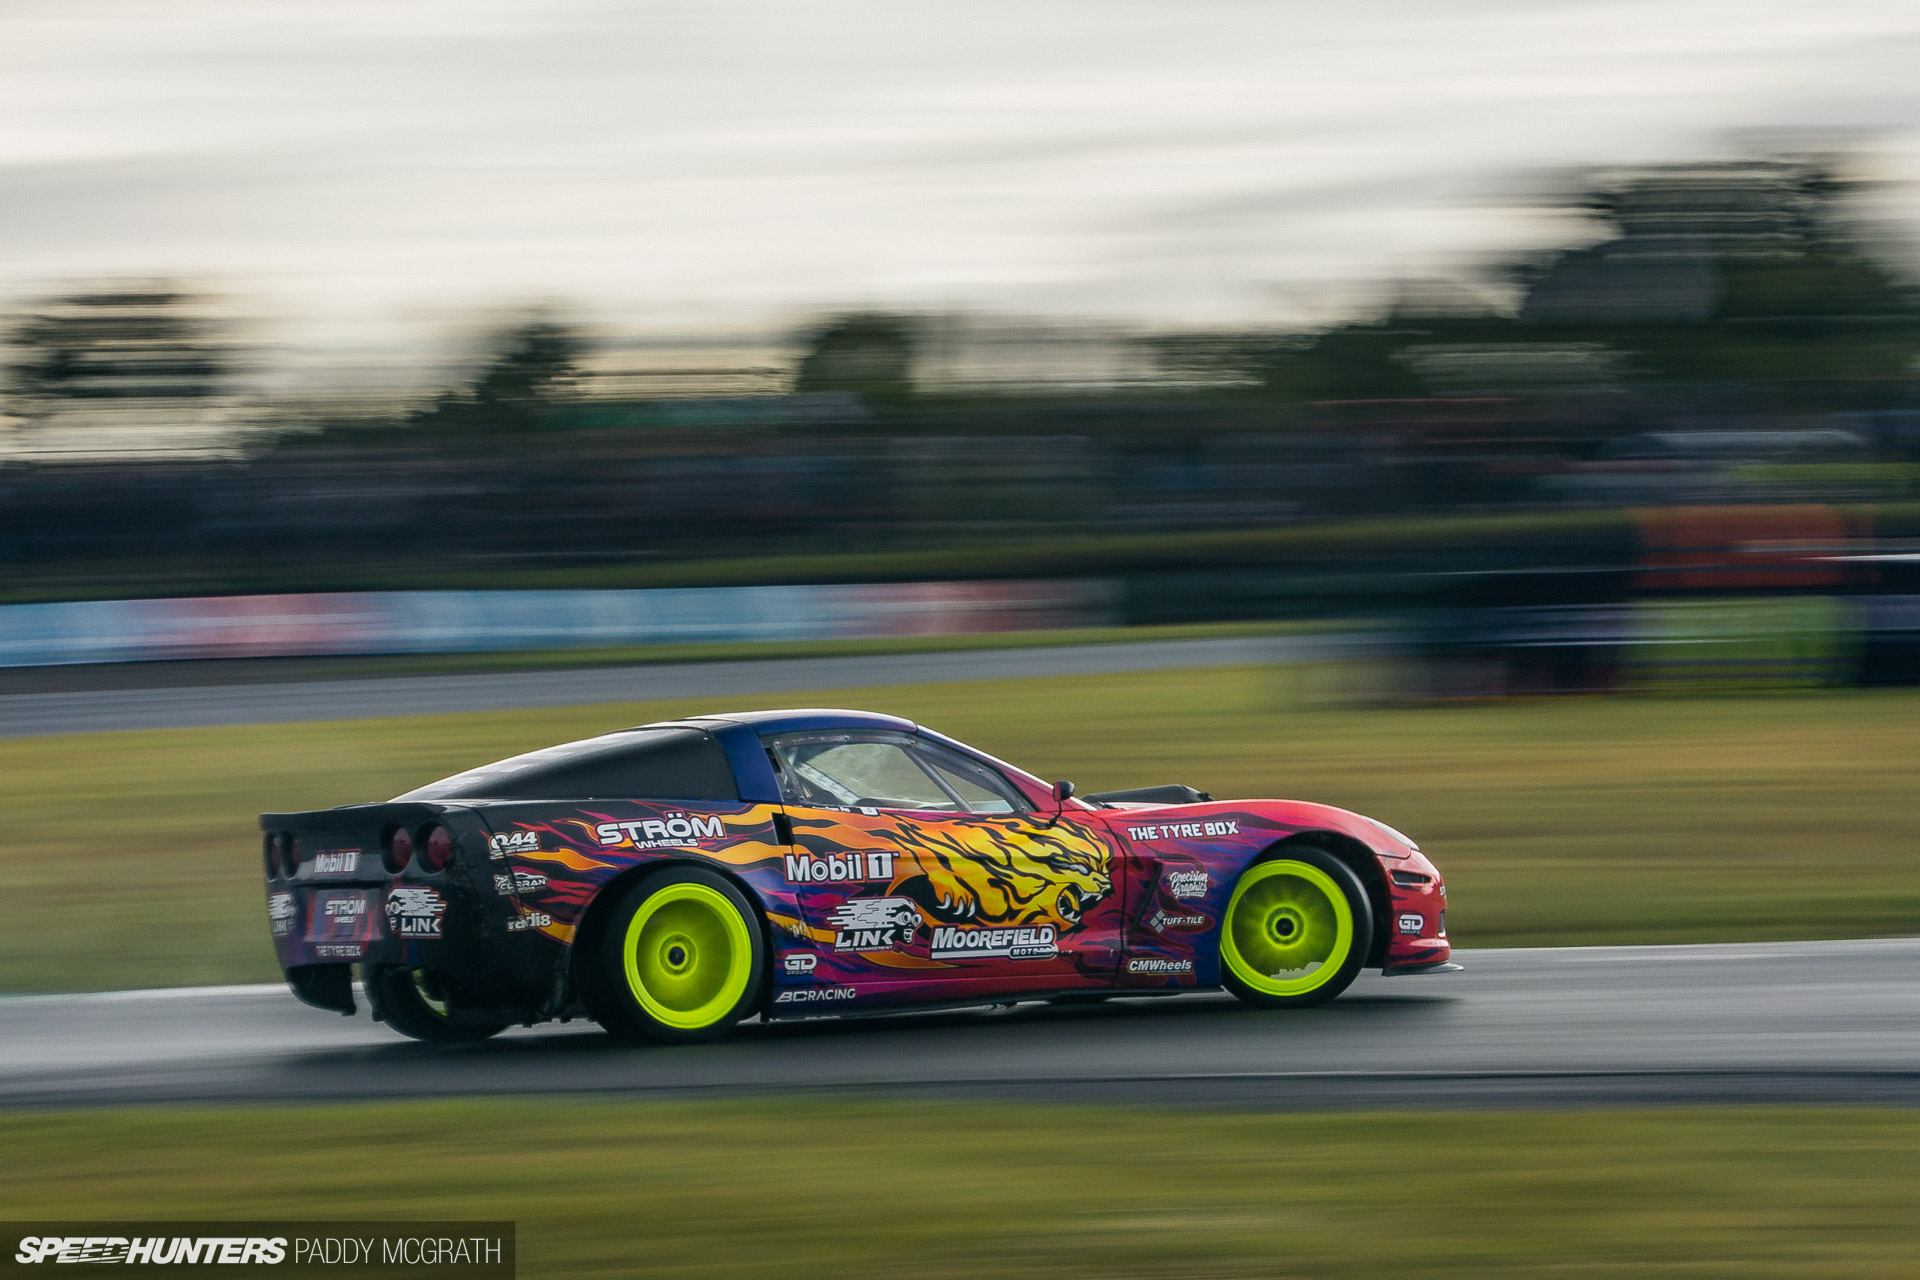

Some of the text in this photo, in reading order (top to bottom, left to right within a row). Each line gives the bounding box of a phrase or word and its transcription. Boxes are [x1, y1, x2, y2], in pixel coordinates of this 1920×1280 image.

[597, 812, 724, 845] STRÖM
[1127, 820, 1239, 841] THE TYRE BOX
[635, 838, 699, 849] WHEELS
[314, 852, 344, 873] Mobil
[786, 854, 863, 882] Mobil
[1169, 870, 1208, 888] Precision
[1172, 881, 1208, 899] Graphics
[325, 895, 366, 915] STRÖM
[401, 917, 441, 933] LINK
[507, 912, 552, 930] radi8
[1162, 916, 1204, 926] TUFF-TILE
[1399, 914, 1424, 930] GD
[835, 929, 896, 948] LINK
[931, 927, 1054, 950] MOOREFIELD
[784, 953, 818, 971] GD
[1129, 959, 1192, 971] CMWheels
